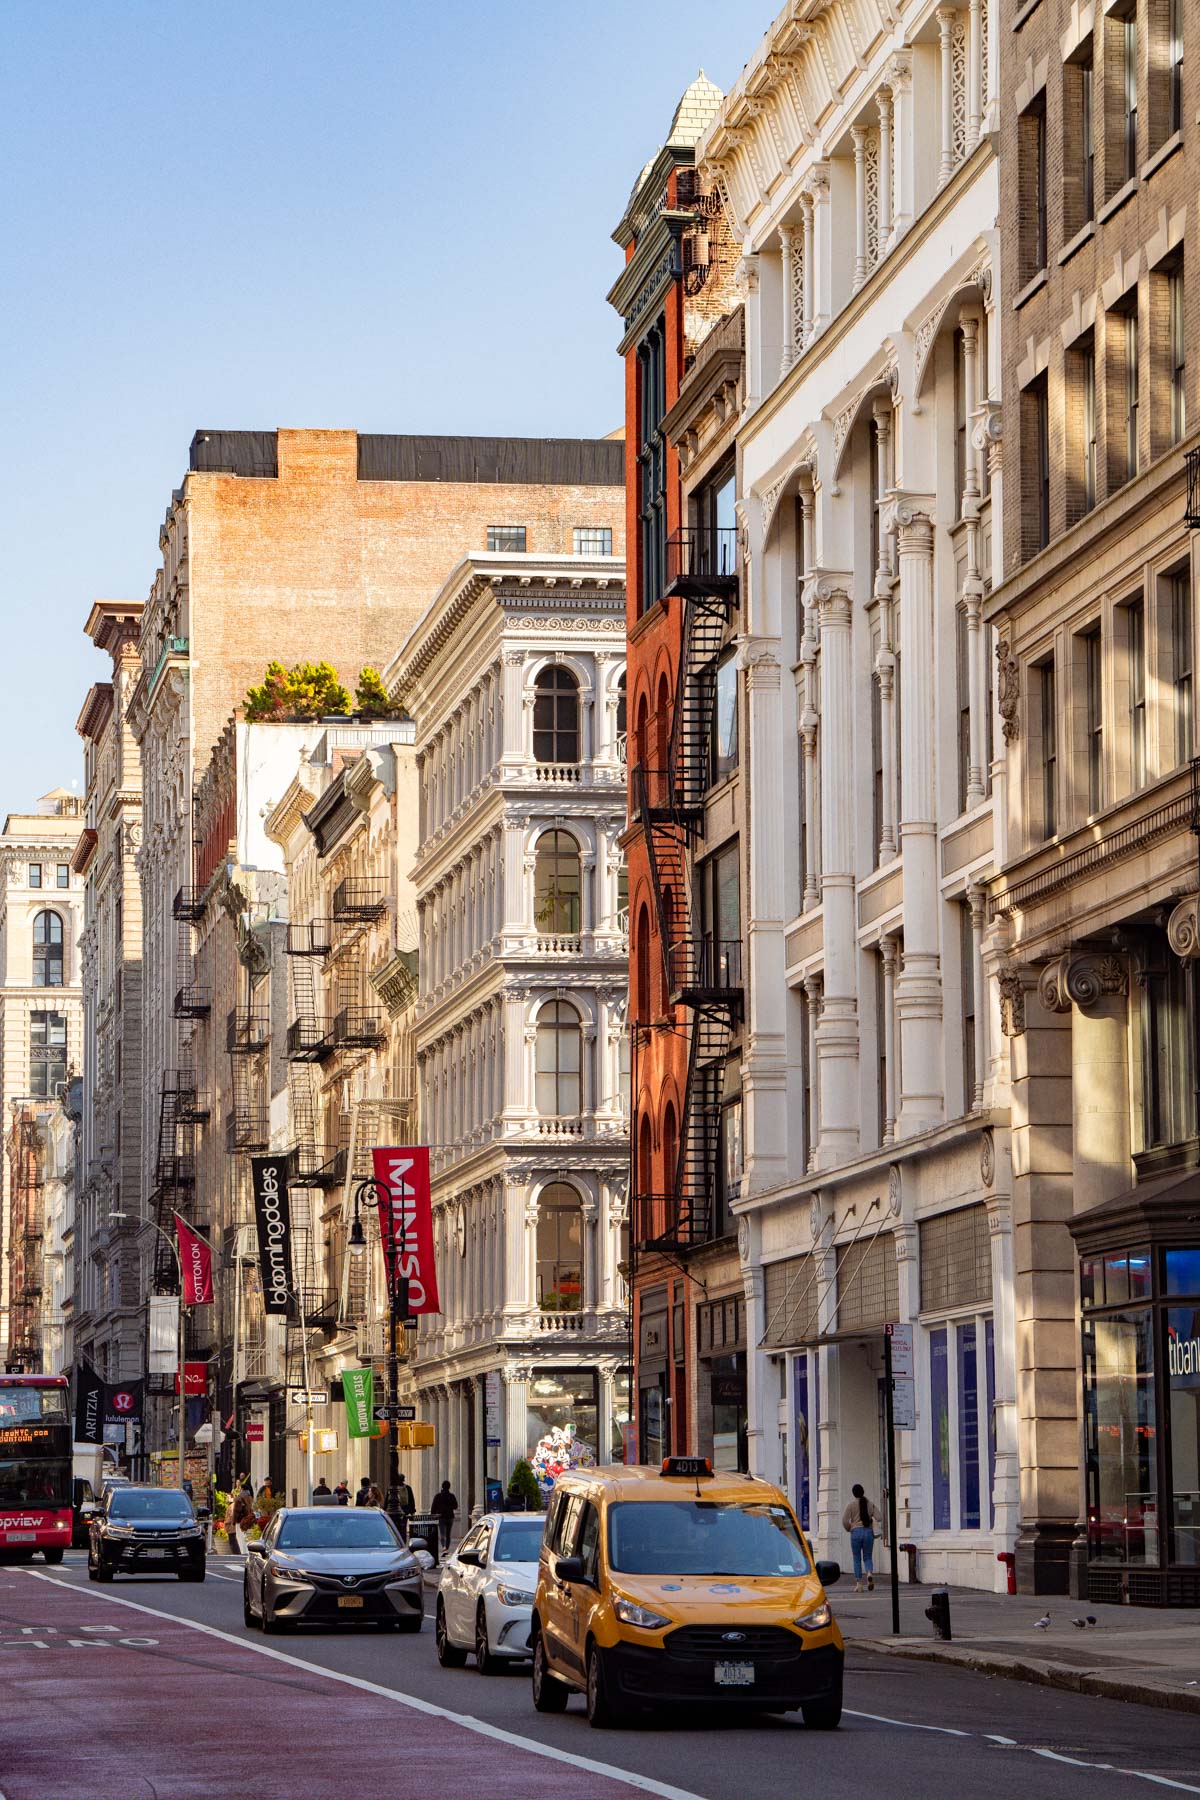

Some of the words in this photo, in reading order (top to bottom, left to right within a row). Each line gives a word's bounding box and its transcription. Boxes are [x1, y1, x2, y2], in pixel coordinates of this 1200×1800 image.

[389, 1158, 426, 1307] MINISO
[191, 1243, 201, 1258] ON
[194, 1260, 204, 1303] COTTON
[886, 1325, 893, 1335] 3
[353, 1375, 365, 1398] STEVE
[86, 1389, 99, 1440] ARITZIA
[105, 1414, 140, 1423] lululemon
[356, 1401, 369, 1433] MADDEN
[676, 1461, 699, 1473] 4D13
[491, 1490, 498, 1500] P
[0, 1625, 124, 1635] BU
